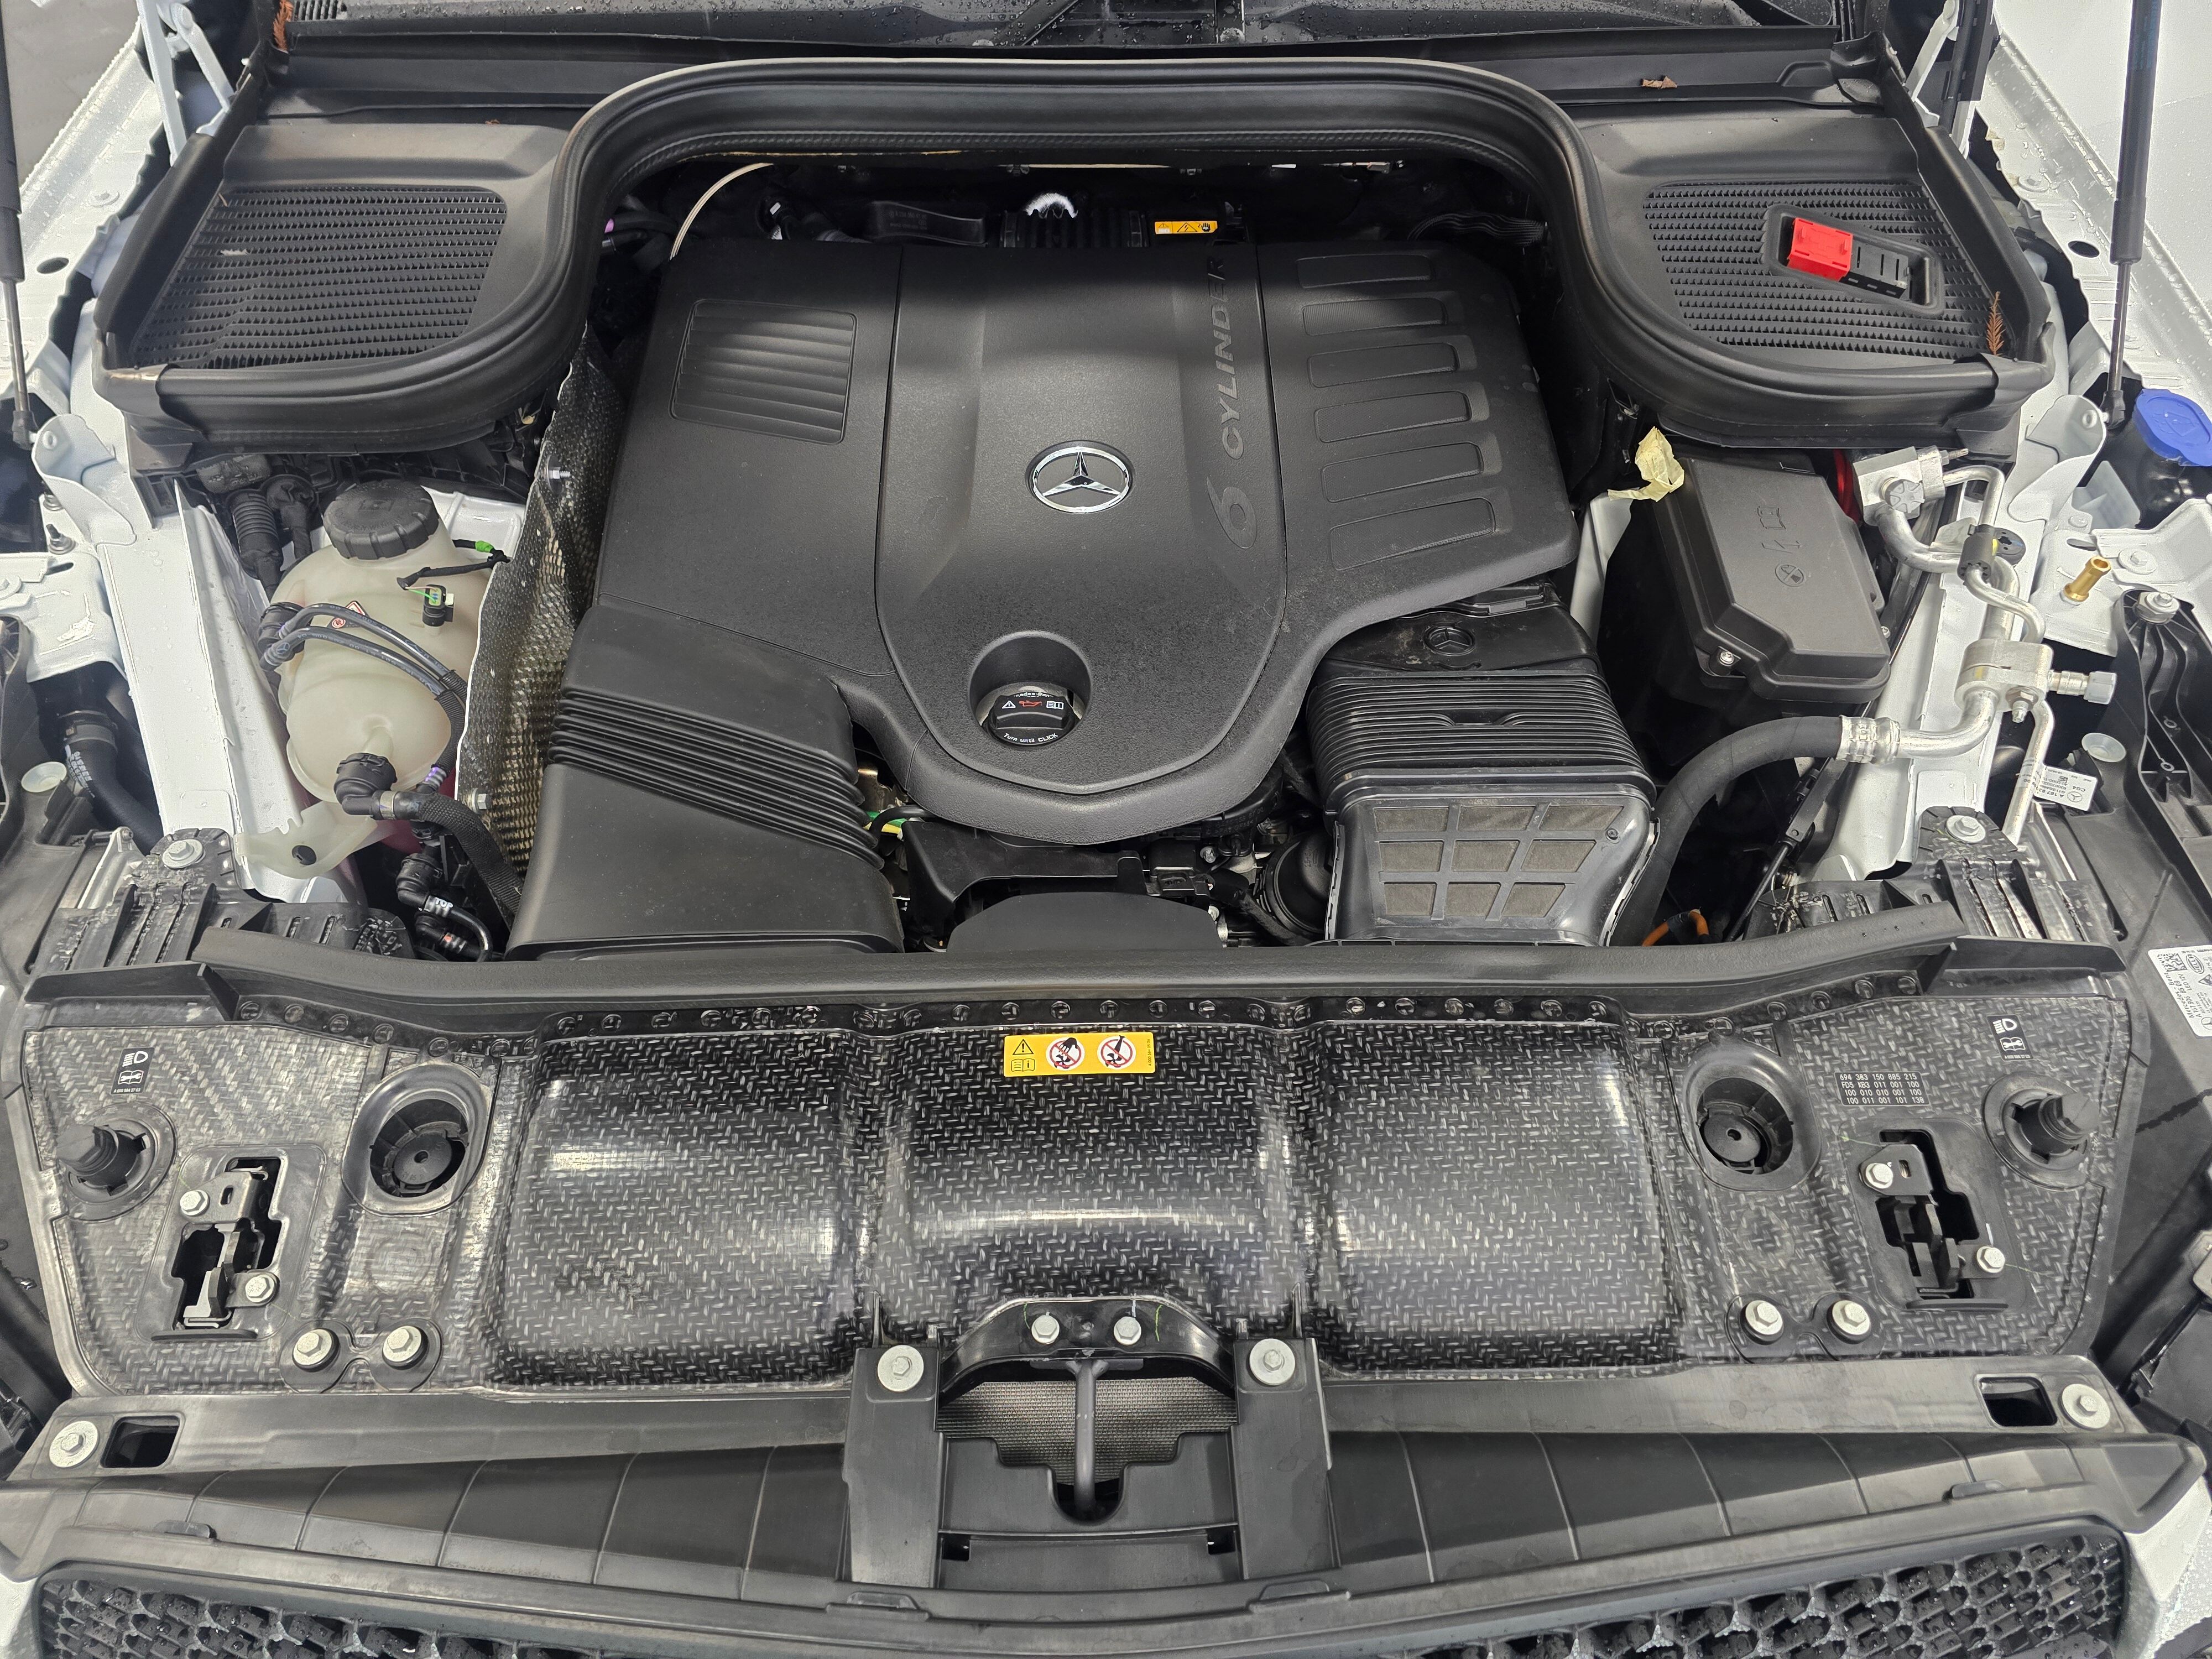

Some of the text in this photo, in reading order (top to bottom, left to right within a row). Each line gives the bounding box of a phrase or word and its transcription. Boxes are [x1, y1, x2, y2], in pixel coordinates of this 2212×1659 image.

[1206, 257, 1258, 549] 6 CYLINDER
[1004, 733, 1018, 742] Turn
[1038, 733, 1058, 742] CLICK
[435, 896, 453, 907] TOP
[2183, 982, 2192, 990] LED
[2191, 1003, 2200, 1013] 167
